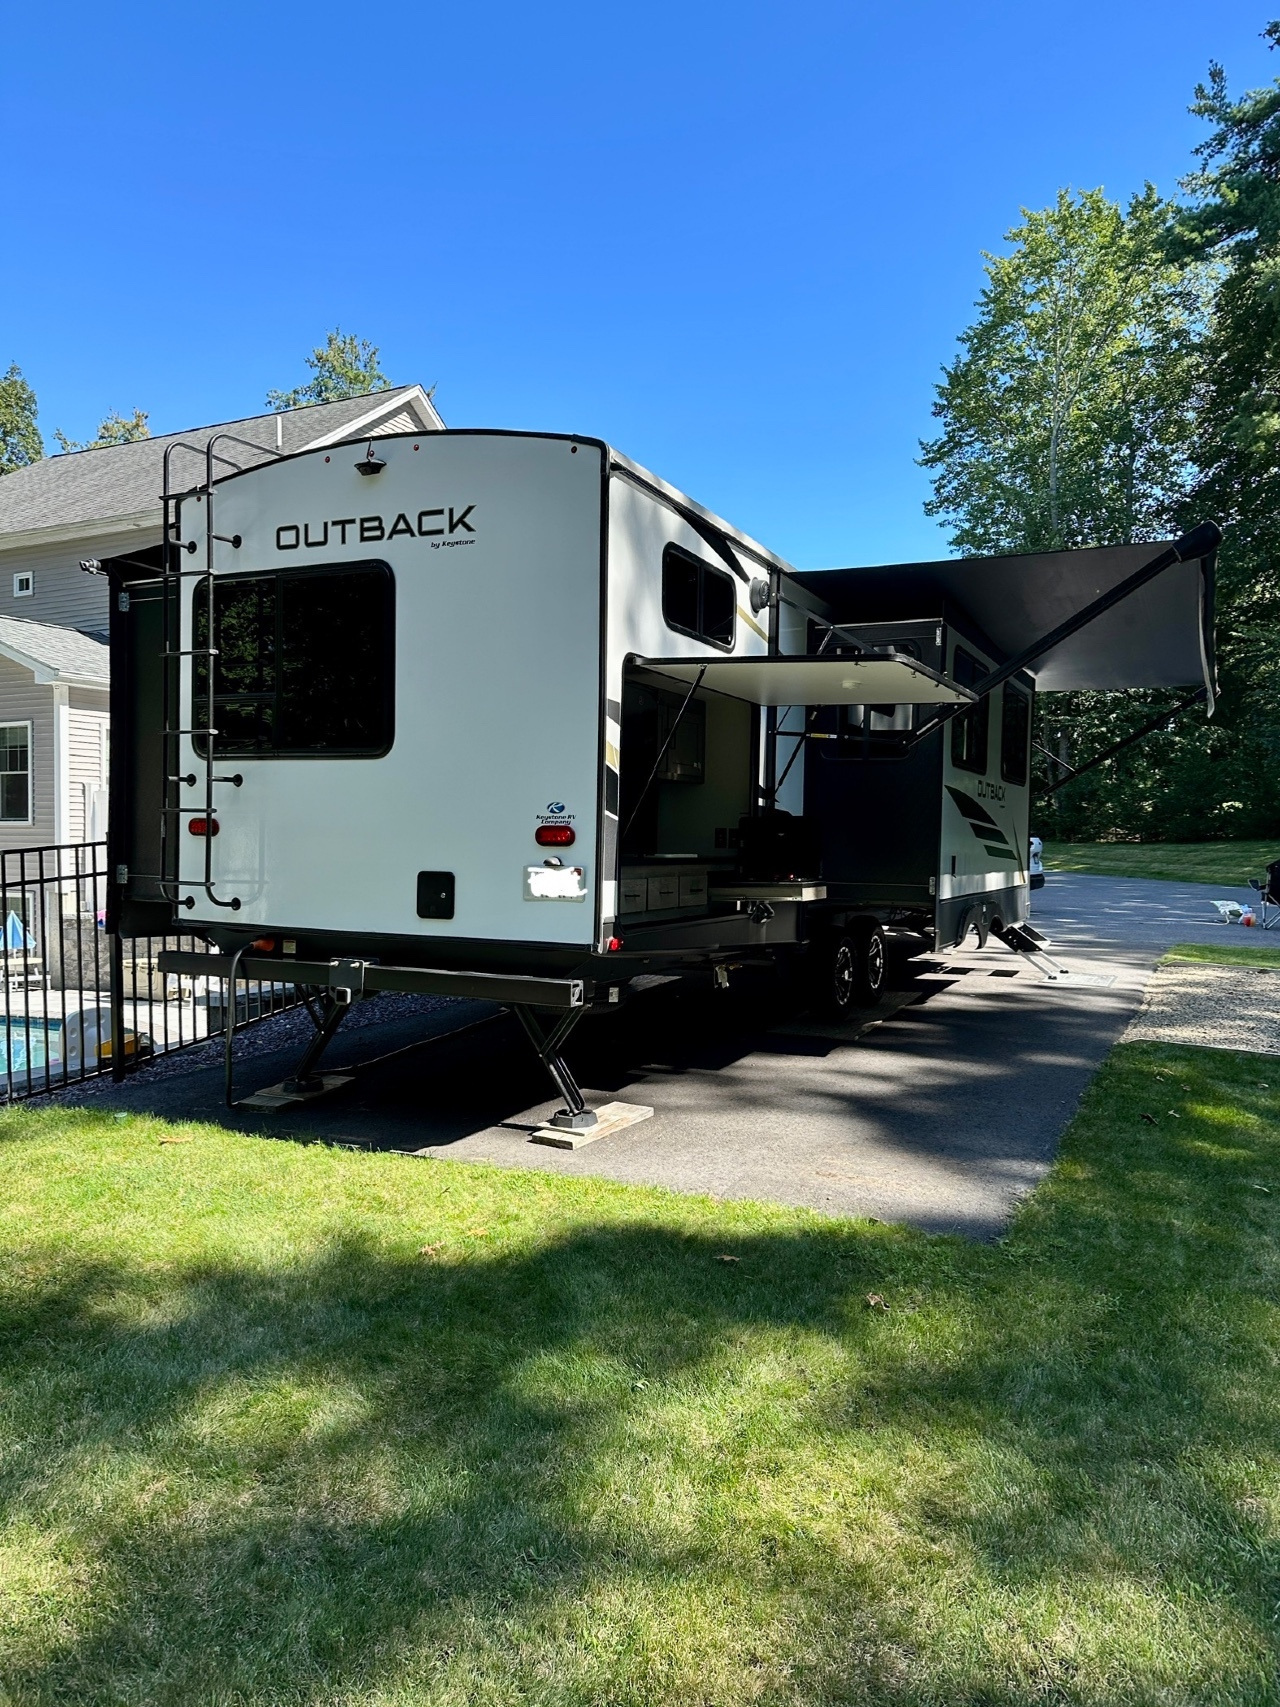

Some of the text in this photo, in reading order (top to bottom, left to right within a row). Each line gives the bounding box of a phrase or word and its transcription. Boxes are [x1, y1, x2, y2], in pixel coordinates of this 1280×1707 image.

[276, 505, 477, 550] OUTBACK
[430, 539, 476, 549] by Keystone
[977, 779, 1006, 801] OUTBACK
